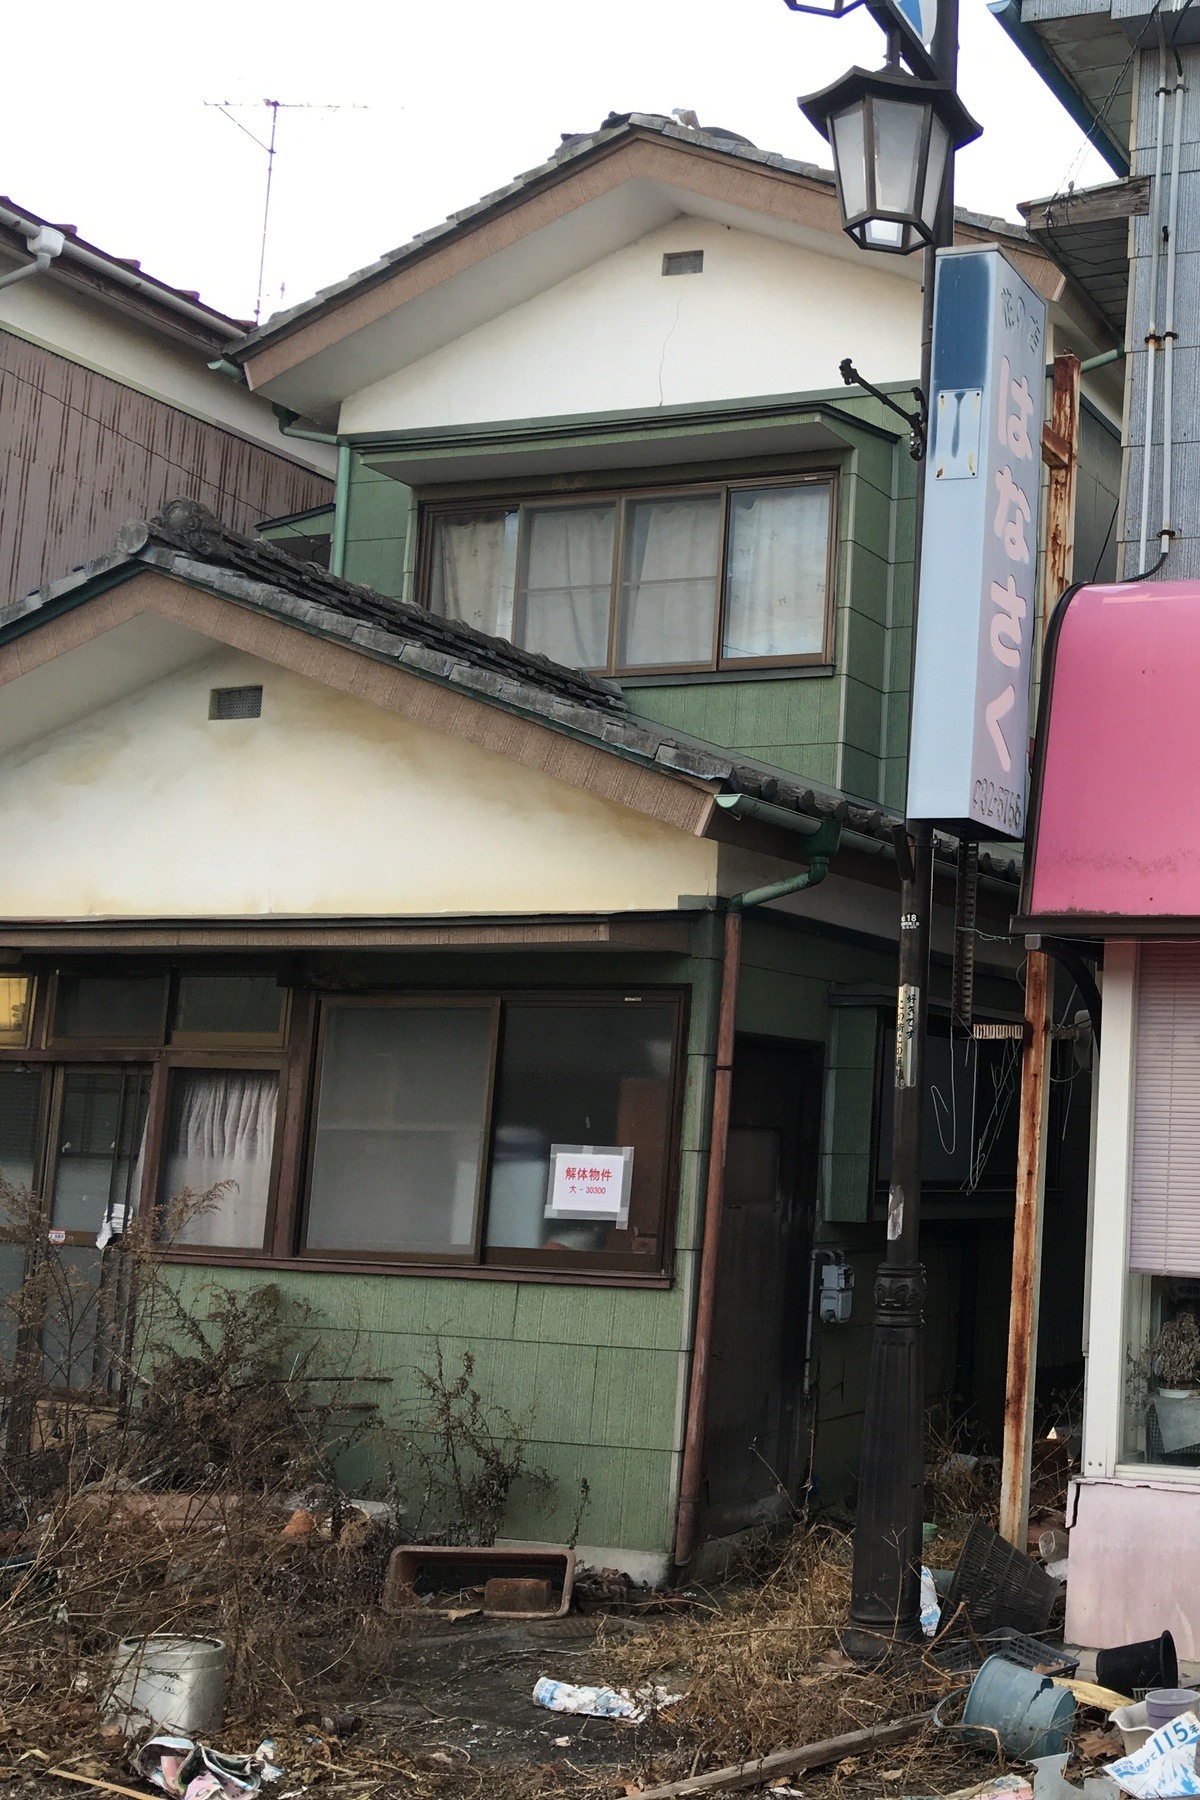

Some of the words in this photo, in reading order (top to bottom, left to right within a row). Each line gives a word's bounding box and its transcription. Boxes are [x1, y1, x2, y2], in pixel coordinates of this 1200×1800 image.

[985, 355, 1034, 772] はなさく
[564, 1167, 612, 1182] 解体物件
